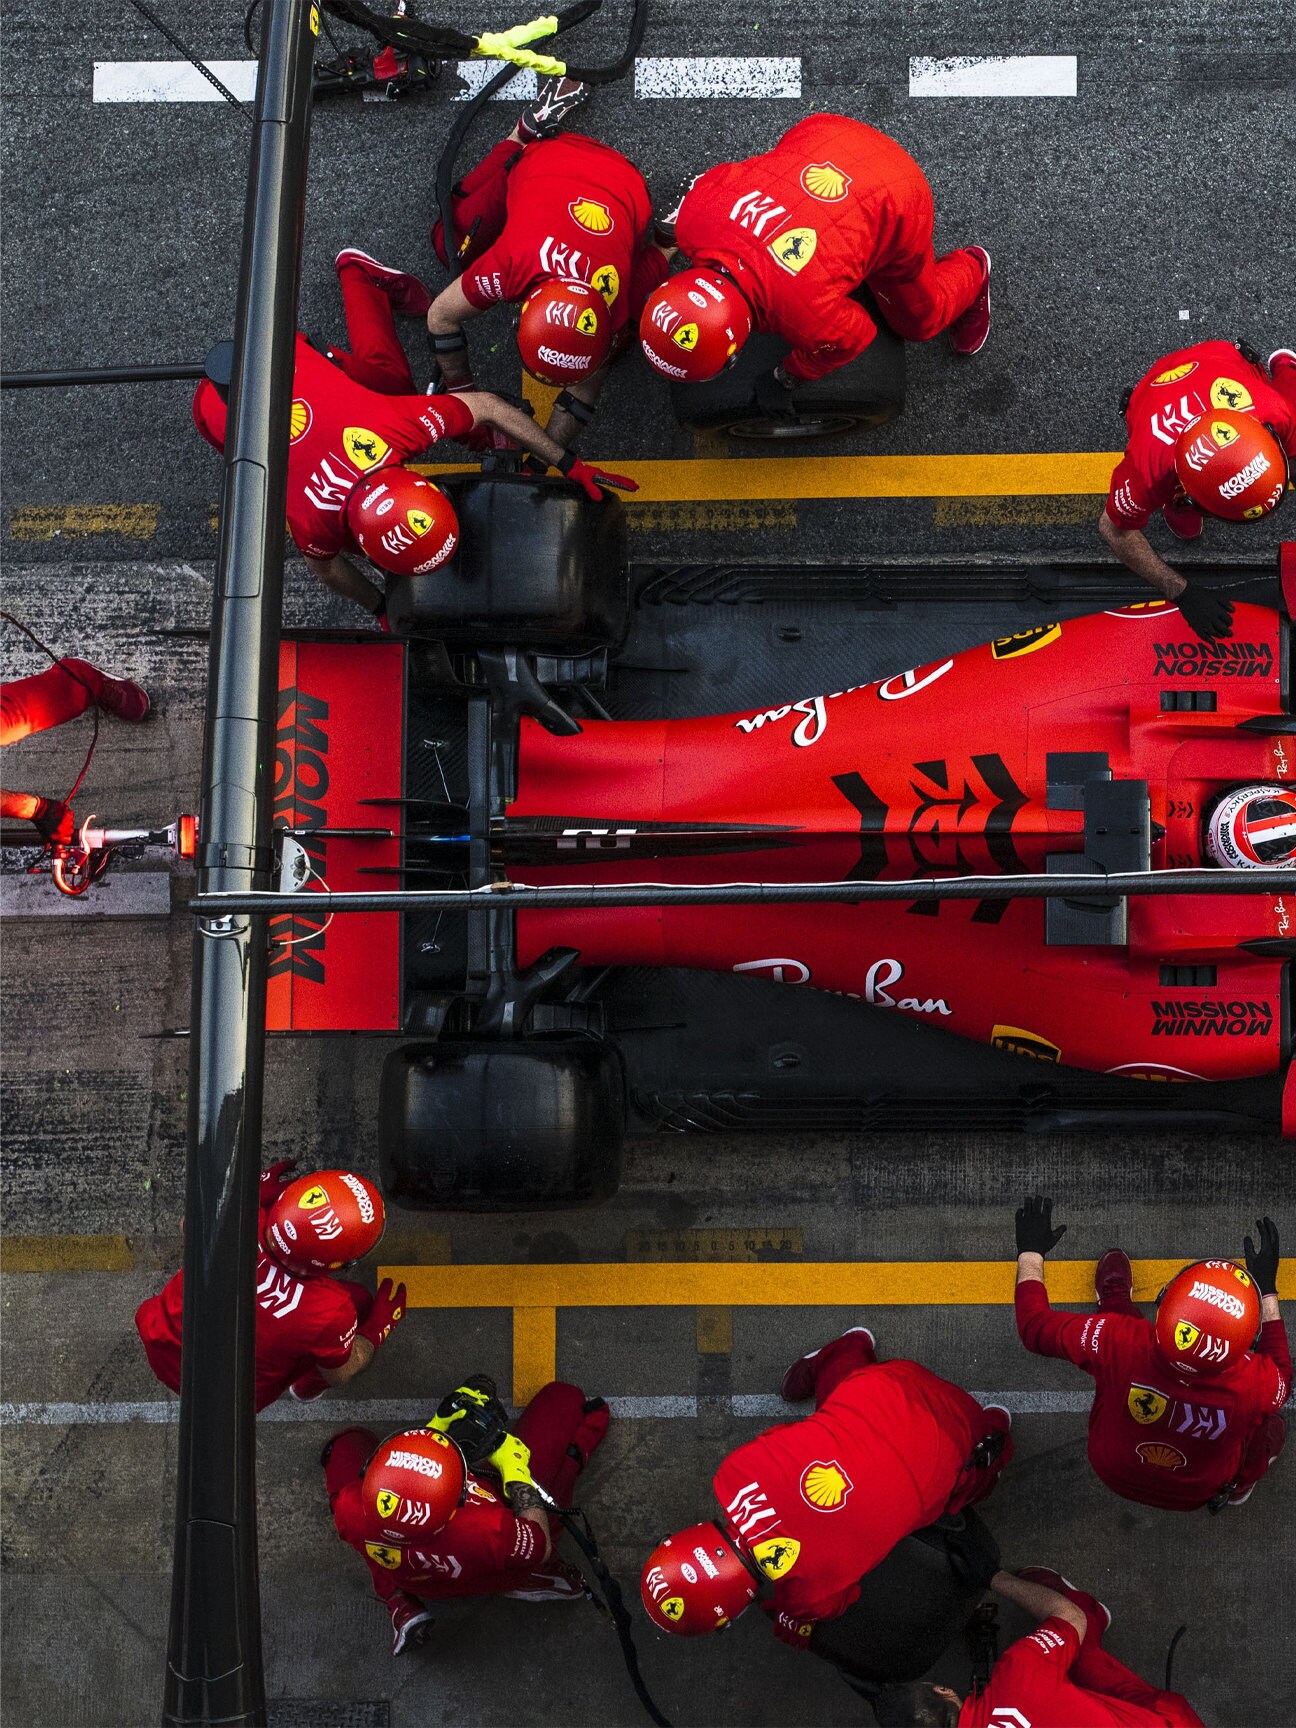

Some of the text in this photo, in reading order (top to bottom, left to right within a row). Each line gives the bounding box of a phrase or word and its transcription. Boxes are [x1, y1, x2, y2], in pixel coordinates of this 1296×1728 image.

[1218, 451, 1267, 495] WINNOW
[1220, 461, 1271, 500] MISSION
[1152, 643, 1273, 660] WINNOW
[1152, 660, 1273, 677] MISSION
[1151, 1001, 1274, 1018] MISSION
[1151, 1019, 1273, 1036] WINNOW
[1189, 1289, 1244, 1319] WINNOW
[1194, 1281, 1245, 1314] MISSION
[1091, 1318, 1106, 1354] HUBLOT
